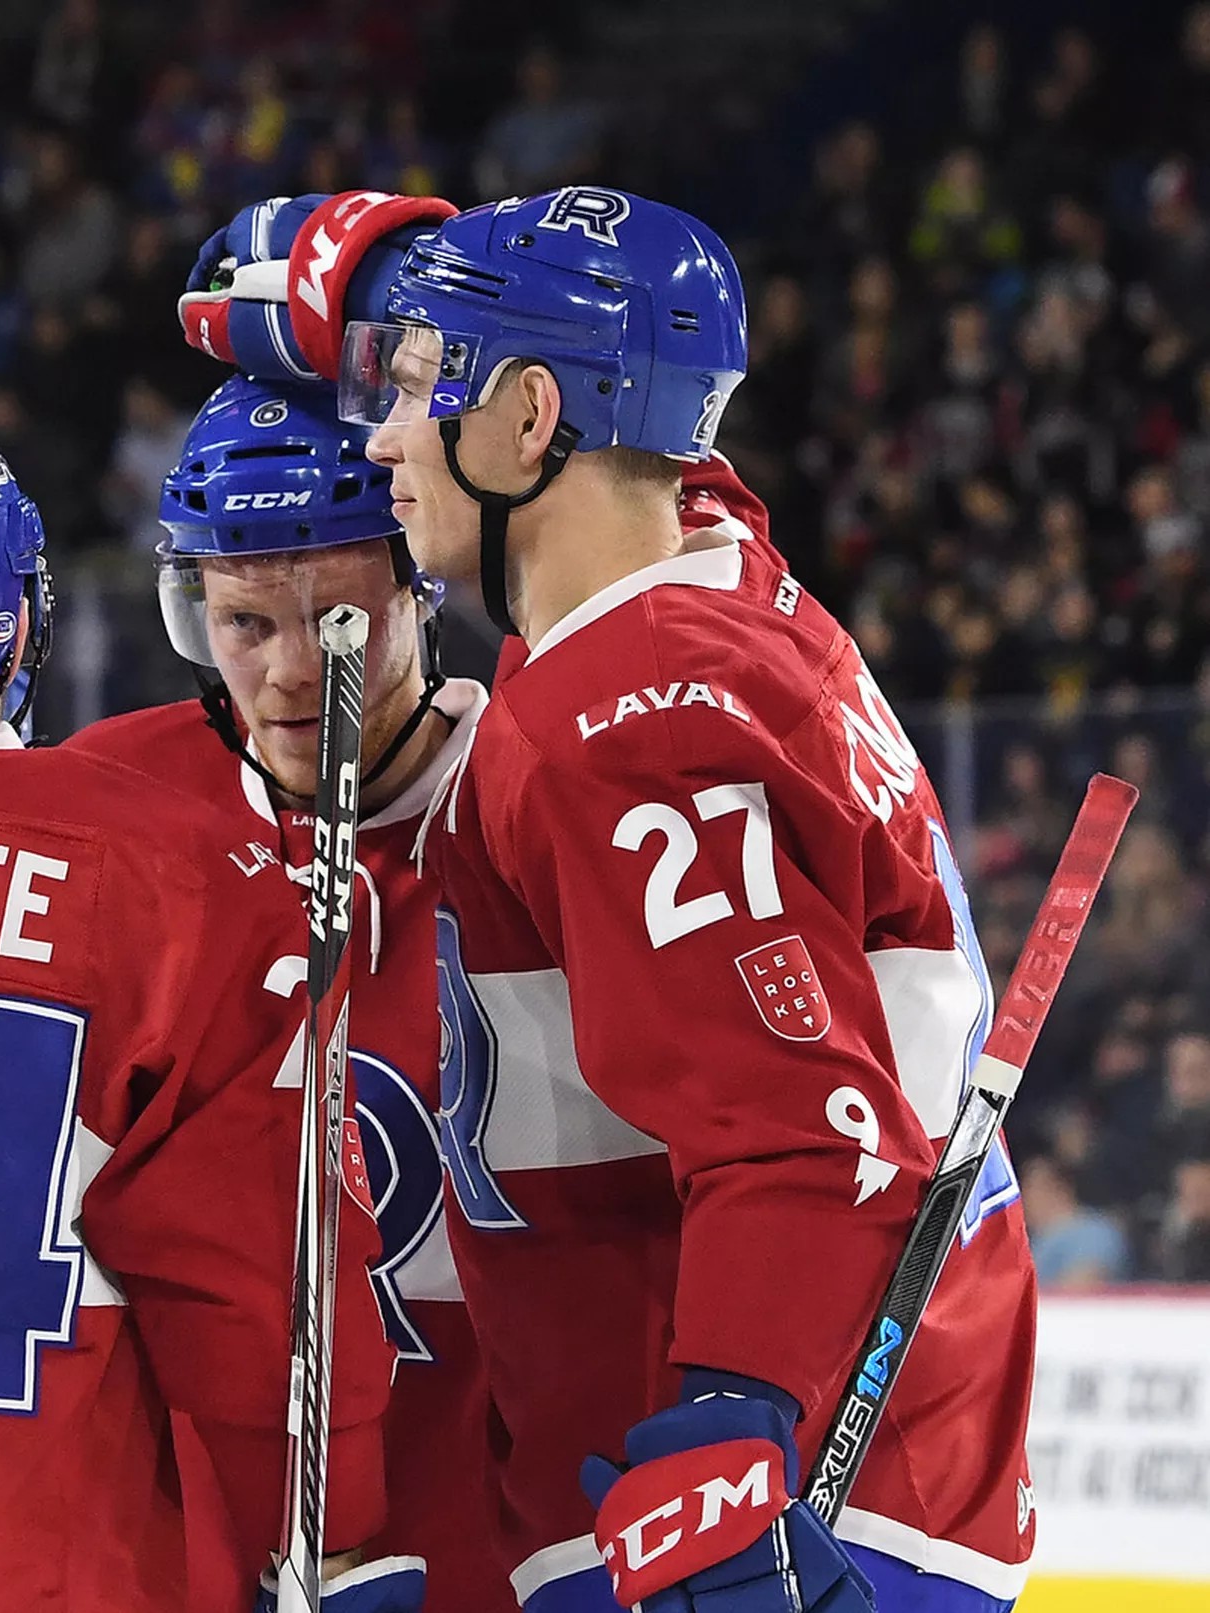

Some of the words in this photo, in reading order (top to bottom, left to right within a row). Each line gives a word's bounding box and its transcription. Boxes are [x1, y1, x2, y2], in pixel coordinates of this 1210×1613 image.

[536, 186, 619, 247] R
[250, 399, 288, 427] 6
[224, 490, 312, 511] CCM
[576, 682, 751, 740] LAVAL
[332, 758, 357, 933] CCM
[612, 782, 784, 950] 27
[311, 815, 331, 943] CCM
